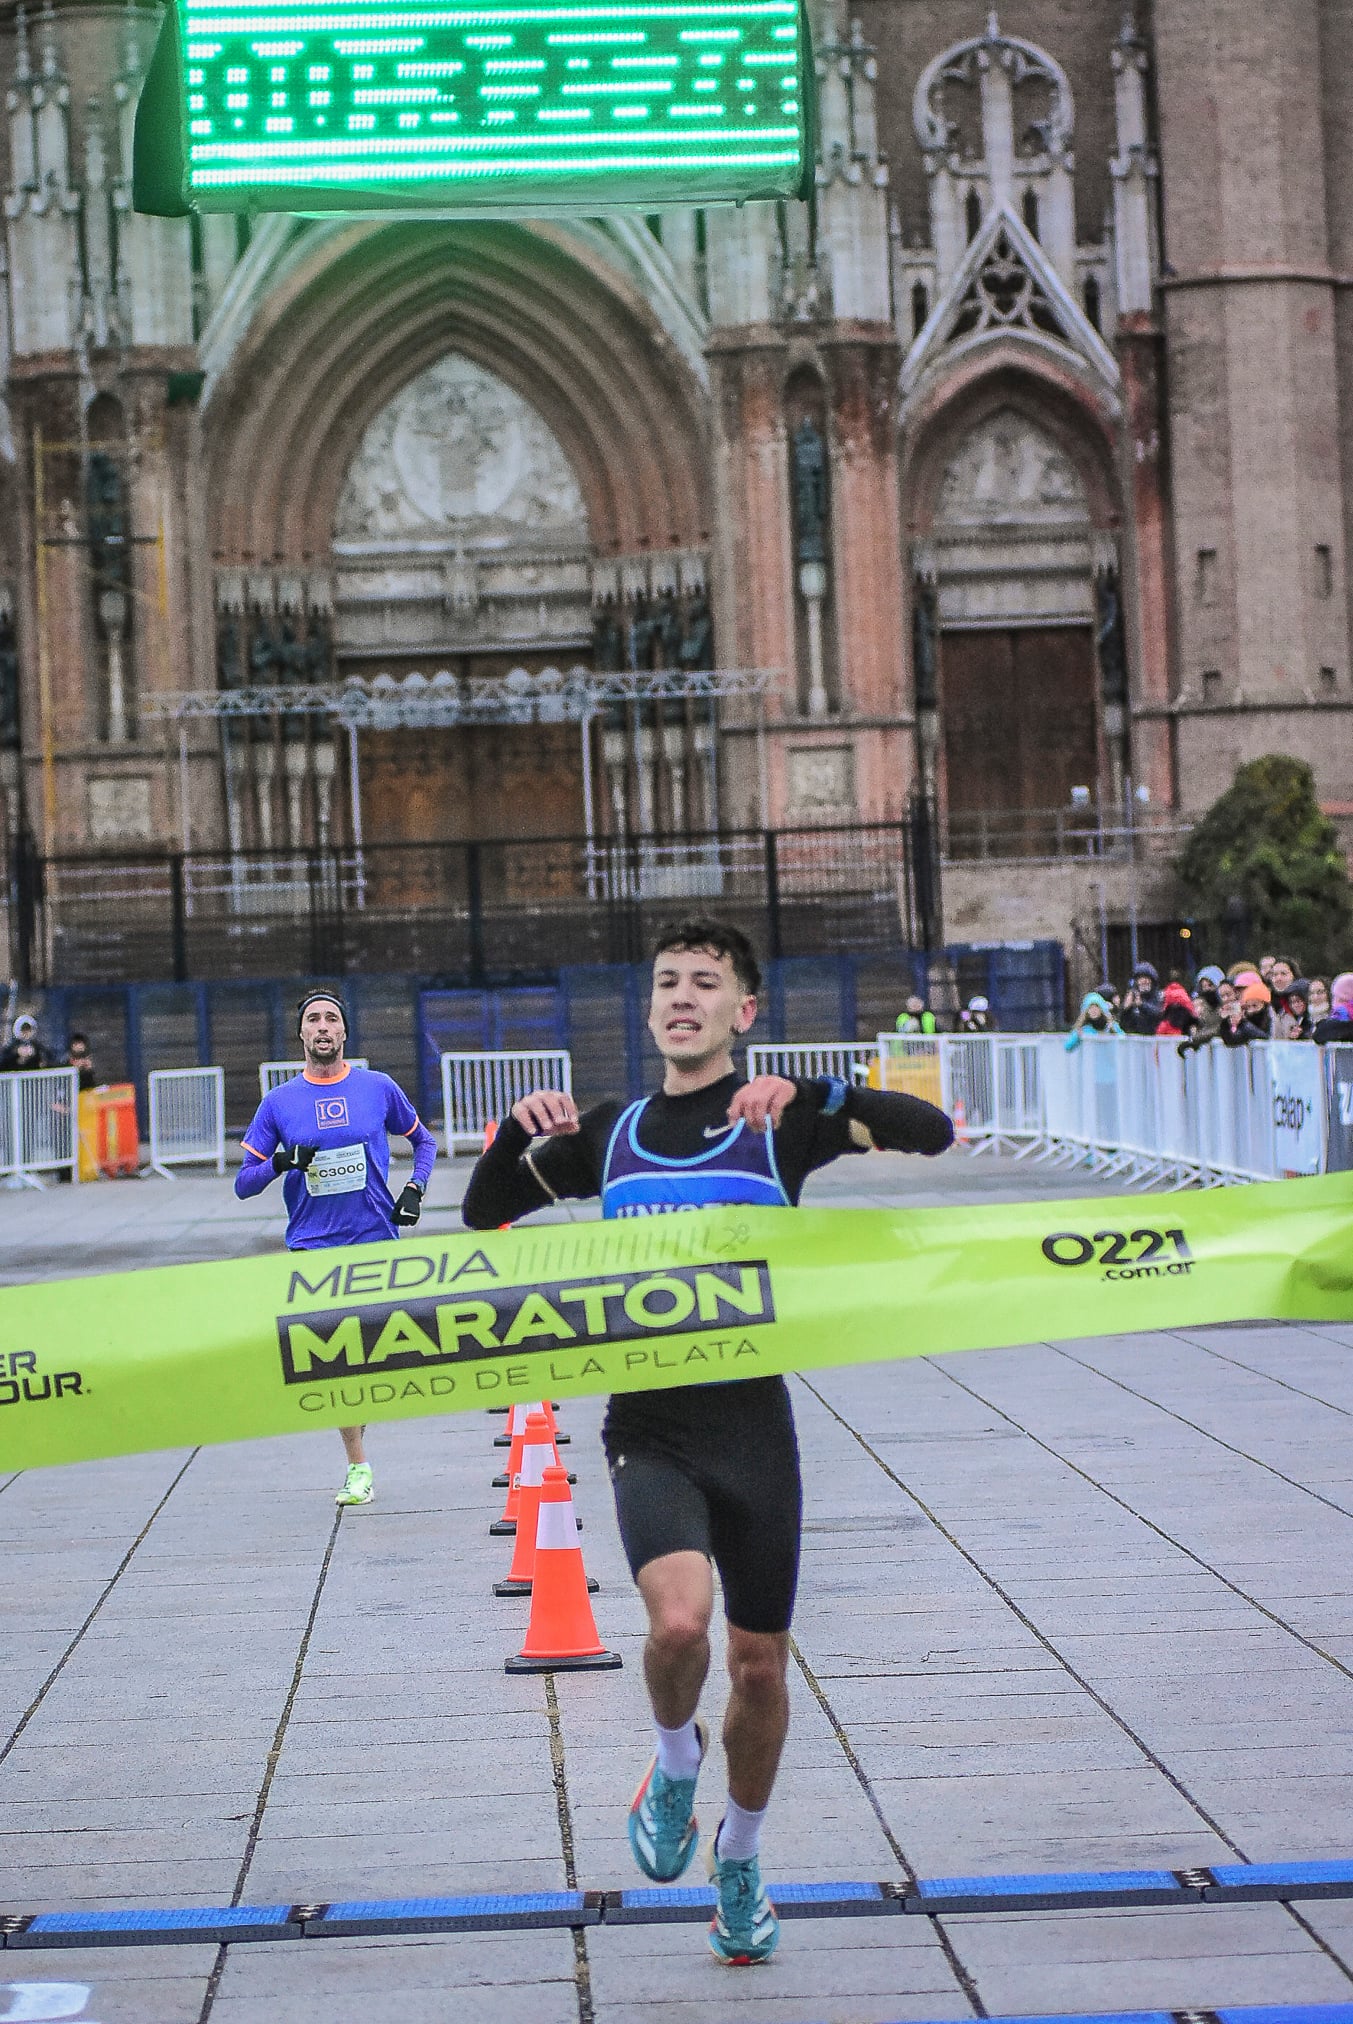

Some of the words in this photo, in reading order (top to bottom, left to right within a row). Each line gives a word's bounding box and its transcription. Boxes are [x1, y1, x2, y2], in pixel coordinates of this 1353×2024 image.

[319, 1163, 365, 1178] C3000
[287, 1249, 499, 1303] MEDIA
[1101, 1261, 1196, 1282] .com.ar
[287, 1266, 765, 1374] MARATÓN
[299, 1375, 456, 1412] CIUDAD
[475, 1365, 529, 1391] DE
[550, 1357, 606, 1382] LA
[624, 1338, 761, 1371] PLATA
